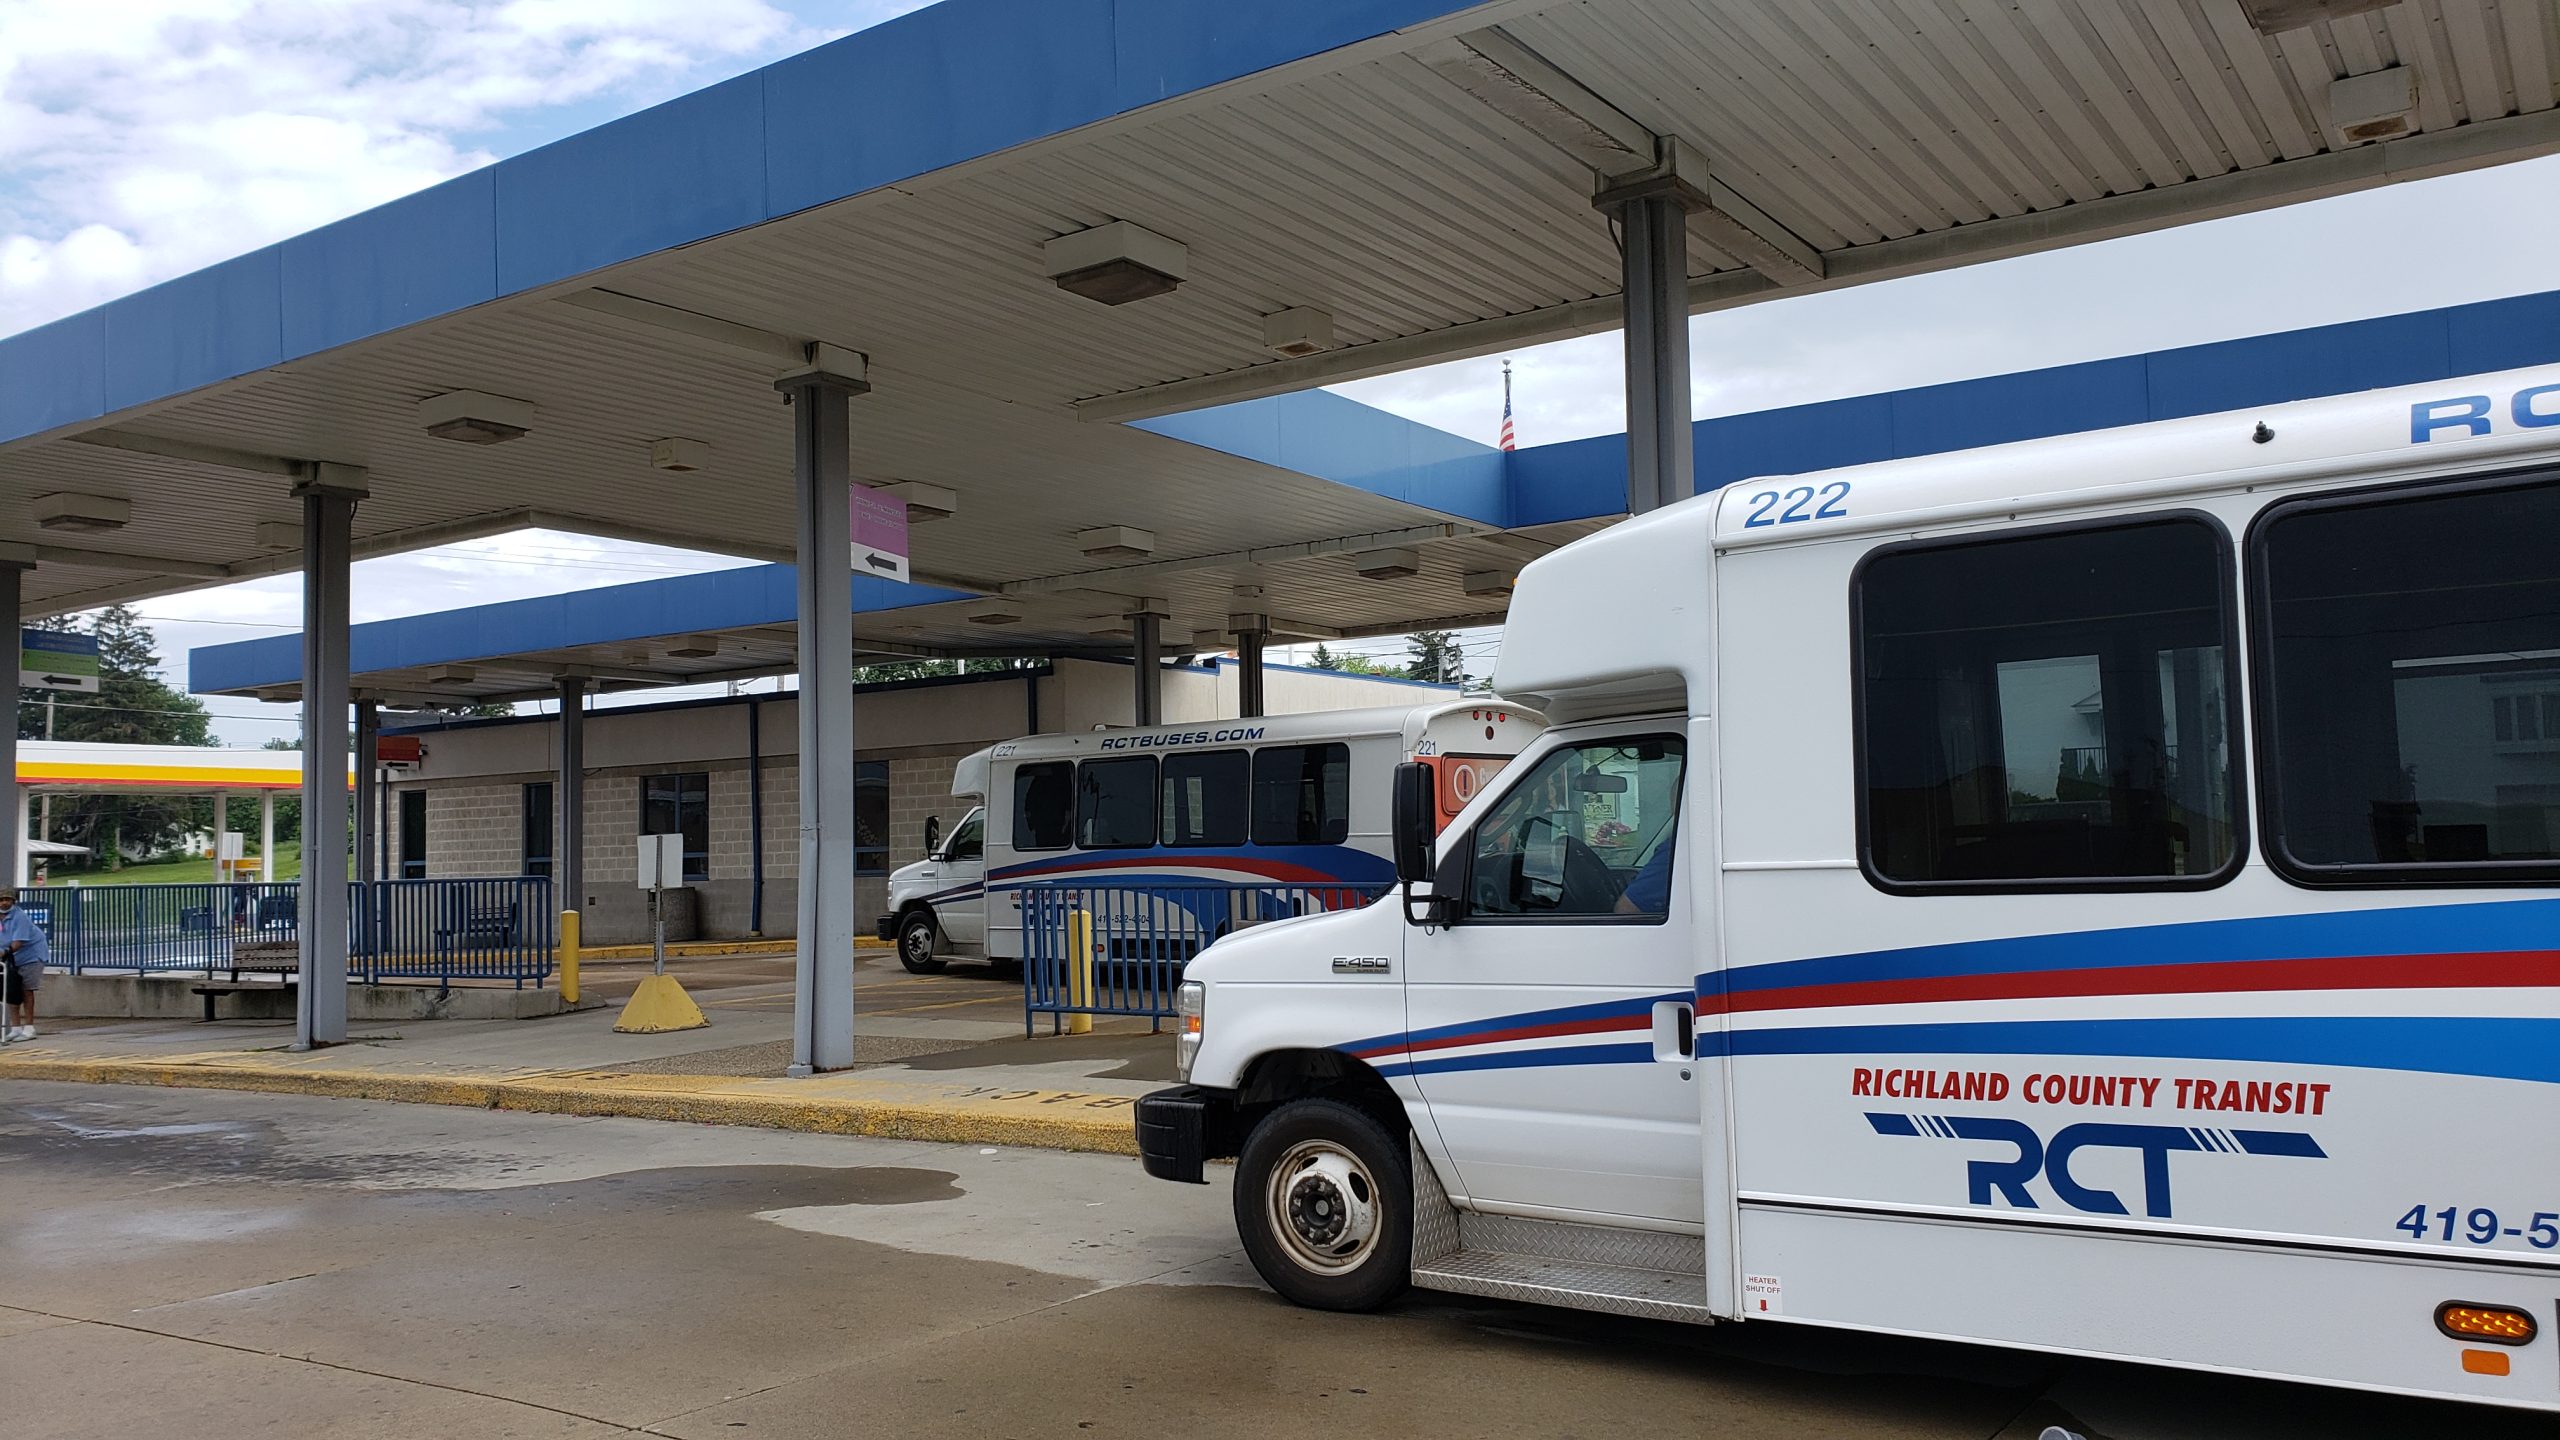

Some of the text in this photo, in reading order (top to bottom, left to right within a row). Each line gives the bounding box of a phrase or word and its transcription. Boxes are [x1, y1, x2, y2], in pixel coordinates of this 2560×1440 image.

[1744, 481, 1851, 529] 222
[1100, 727, 1265, 750] RCTBUSES.COM
[1418, 740, 1436, 755] 221
[996, 745, 1017, 756] 221
[1851, 1067, 2331, 1116] RICHLAND COUNTY TRANSIT
[1944, 1115, 2204, 1219] RCT
[2395, 1204, 2560, 1249] 419-5
[1745, 1284, 1781, 1294] SHUT OFF
[1748, 1275, 1777, 1285] HEATER
